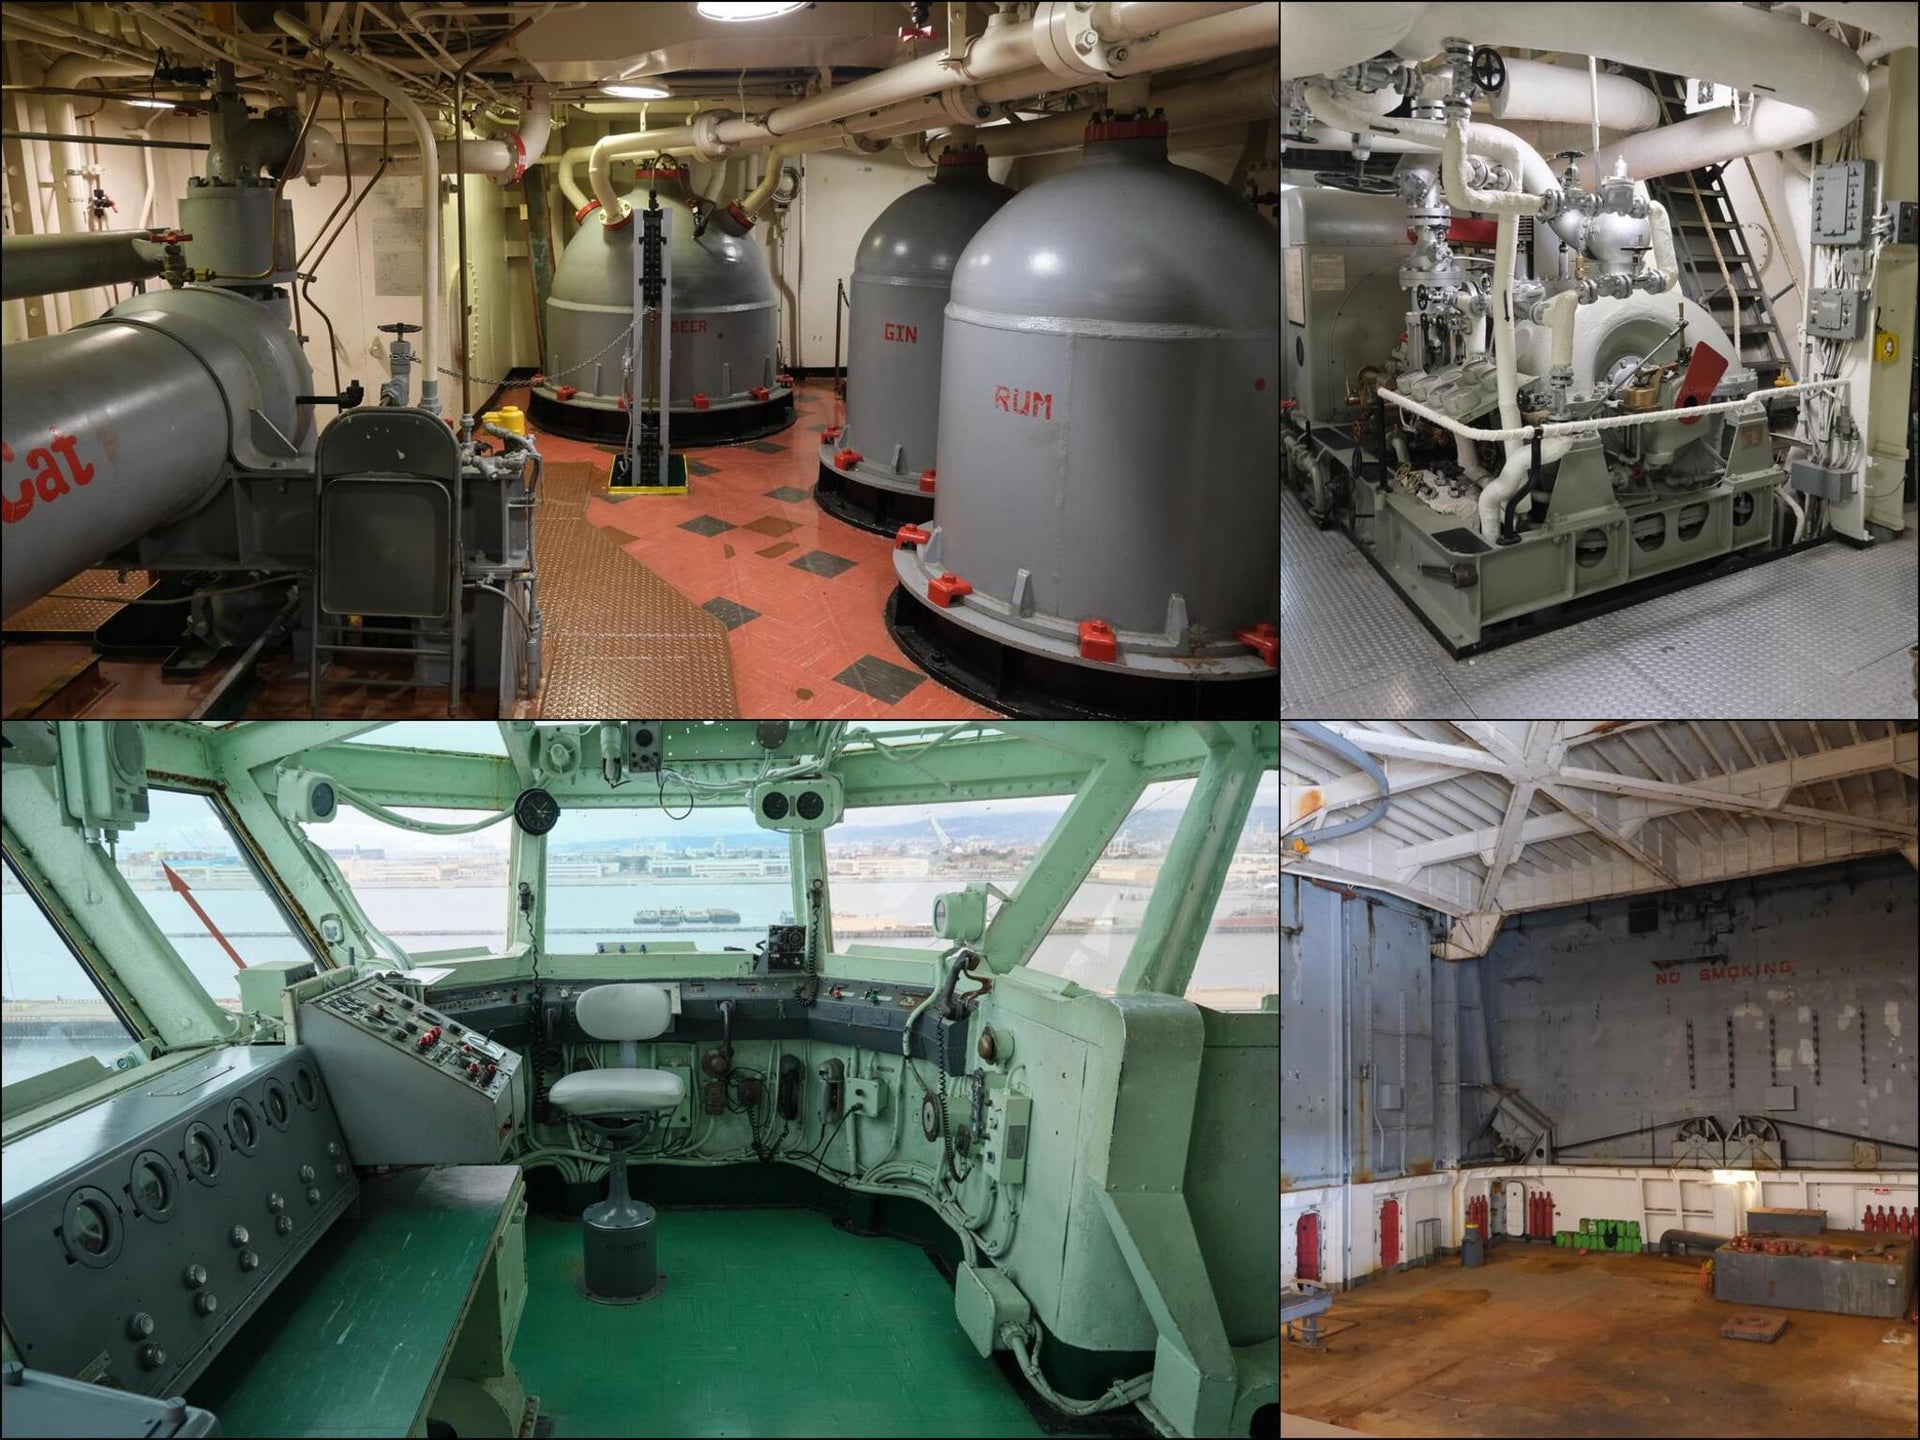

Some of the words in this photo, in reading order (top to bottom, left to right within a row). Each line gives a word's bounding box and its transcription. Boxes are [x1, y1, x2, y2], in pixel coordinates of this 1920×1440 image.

[671, 319, 708, 333] BEER
[884, 322, 918, 344] GIN
[995, 384, 1052, 420] RUM
[1655, 972, 1681, 985] NO
[1699, 960, 1793, 982] SMOKING
